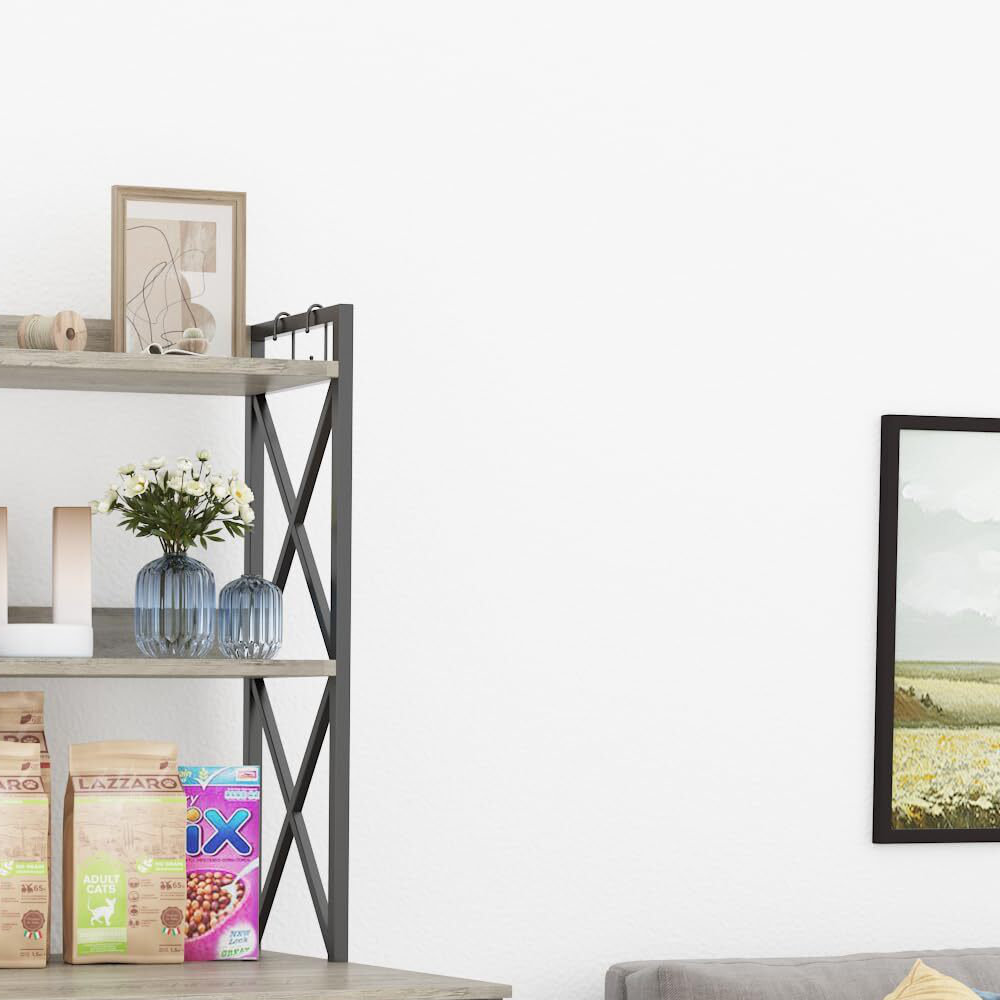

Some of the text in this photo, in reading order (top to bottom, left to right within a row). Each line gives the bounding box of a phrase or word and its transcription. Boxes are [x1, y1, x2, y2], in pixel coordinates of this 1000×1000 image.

[78, 778, 178, 789] LAZZARO
[83, 874, 121, 884] ADULT
[86, 884, 116, 894] CATS
